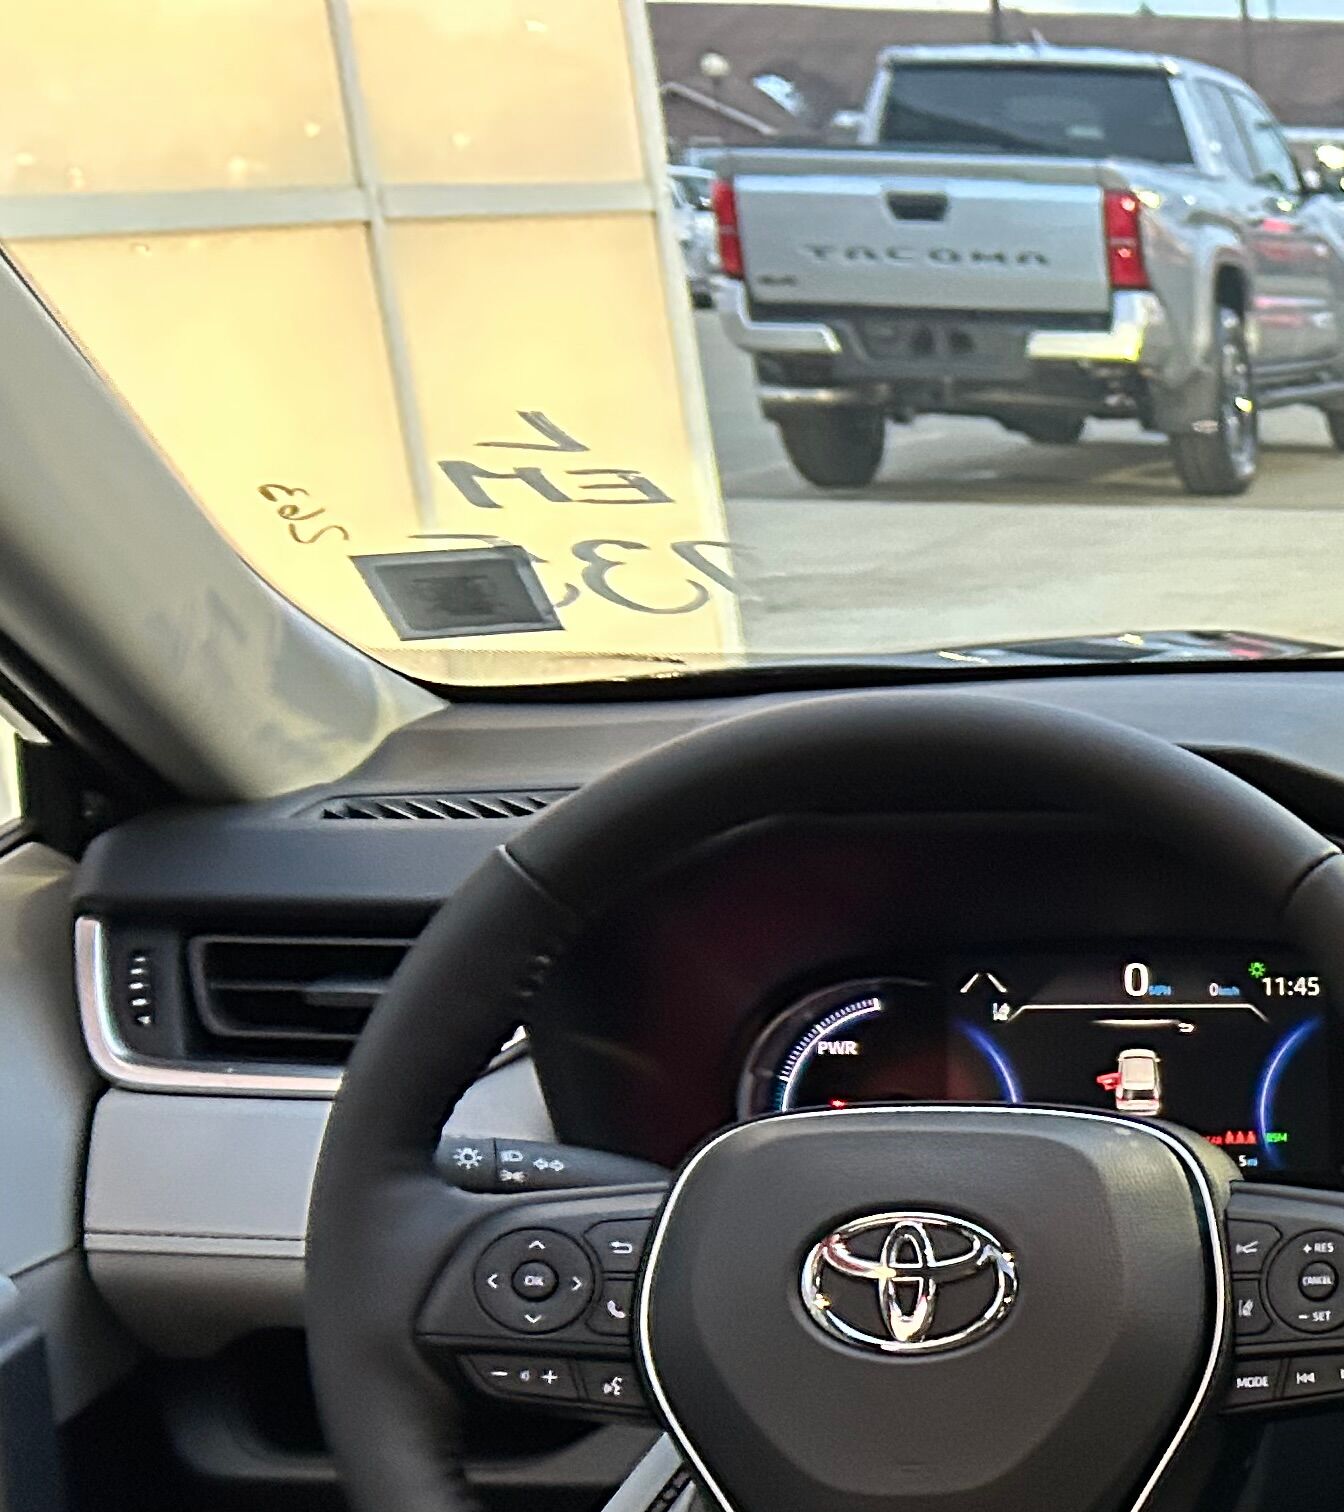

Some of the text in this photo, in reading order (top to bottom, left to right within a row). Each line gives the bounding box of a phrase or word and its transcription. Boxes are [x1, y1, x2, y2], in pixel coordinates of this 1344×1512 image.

[804, 244, 1050, 265] TACOMA
[1124, 962, 1149, 997] 0
[1262, 976, 1320, 996] 11:45
[817, 1040, 858, 1055] PWR
[1314, 1242, 1334, 1253] RES
[1302, 1275, 1332, 1287] CANCEL
[1312, 1310, 1331, 1322] SET
[1236, 1375, 1269, 1388] MODE
